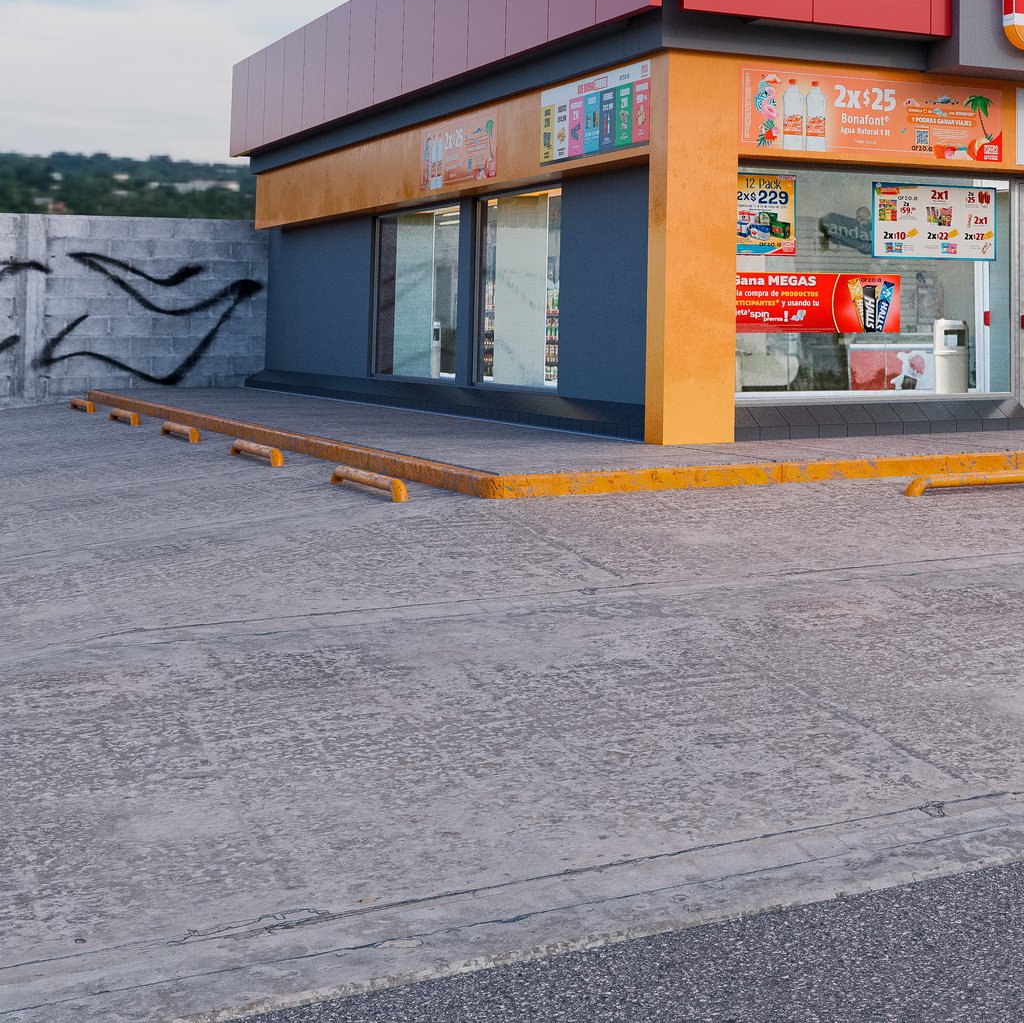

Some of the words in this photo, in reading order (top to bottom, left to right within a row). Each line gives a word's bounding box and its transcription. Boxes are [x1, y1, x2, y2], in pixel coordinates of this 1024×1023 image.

[834, 84, 897, 112] 2x$25
[915, 116, 936, 124] PODRÁS
[955, 119, 972, 127] VIAJES
[840, 127, 856, 135] Agua
[857, 127, 878, 136] Natural
[745, 178, 756, 189] 12
[759, 178, 782, 190] Pack
[930, 189, 949, 200] 2x1
[965, 196, 976, 204] $25
[974, 216, 988, 225] 2x1
[883, 231, 906, 240] 2x$10
[927, 232, 949, 241] 2x$22
[964, 232, 985, 241] 2x$27
[768, 275, 817, 286] MEGAS
[744, 290, 769, 298] compra
[770, 289, 779, 297] de
[781, 300, 786, 308] y
[750, 310, 770, 319] spin
[864, 295, 875, 329] HALLS
